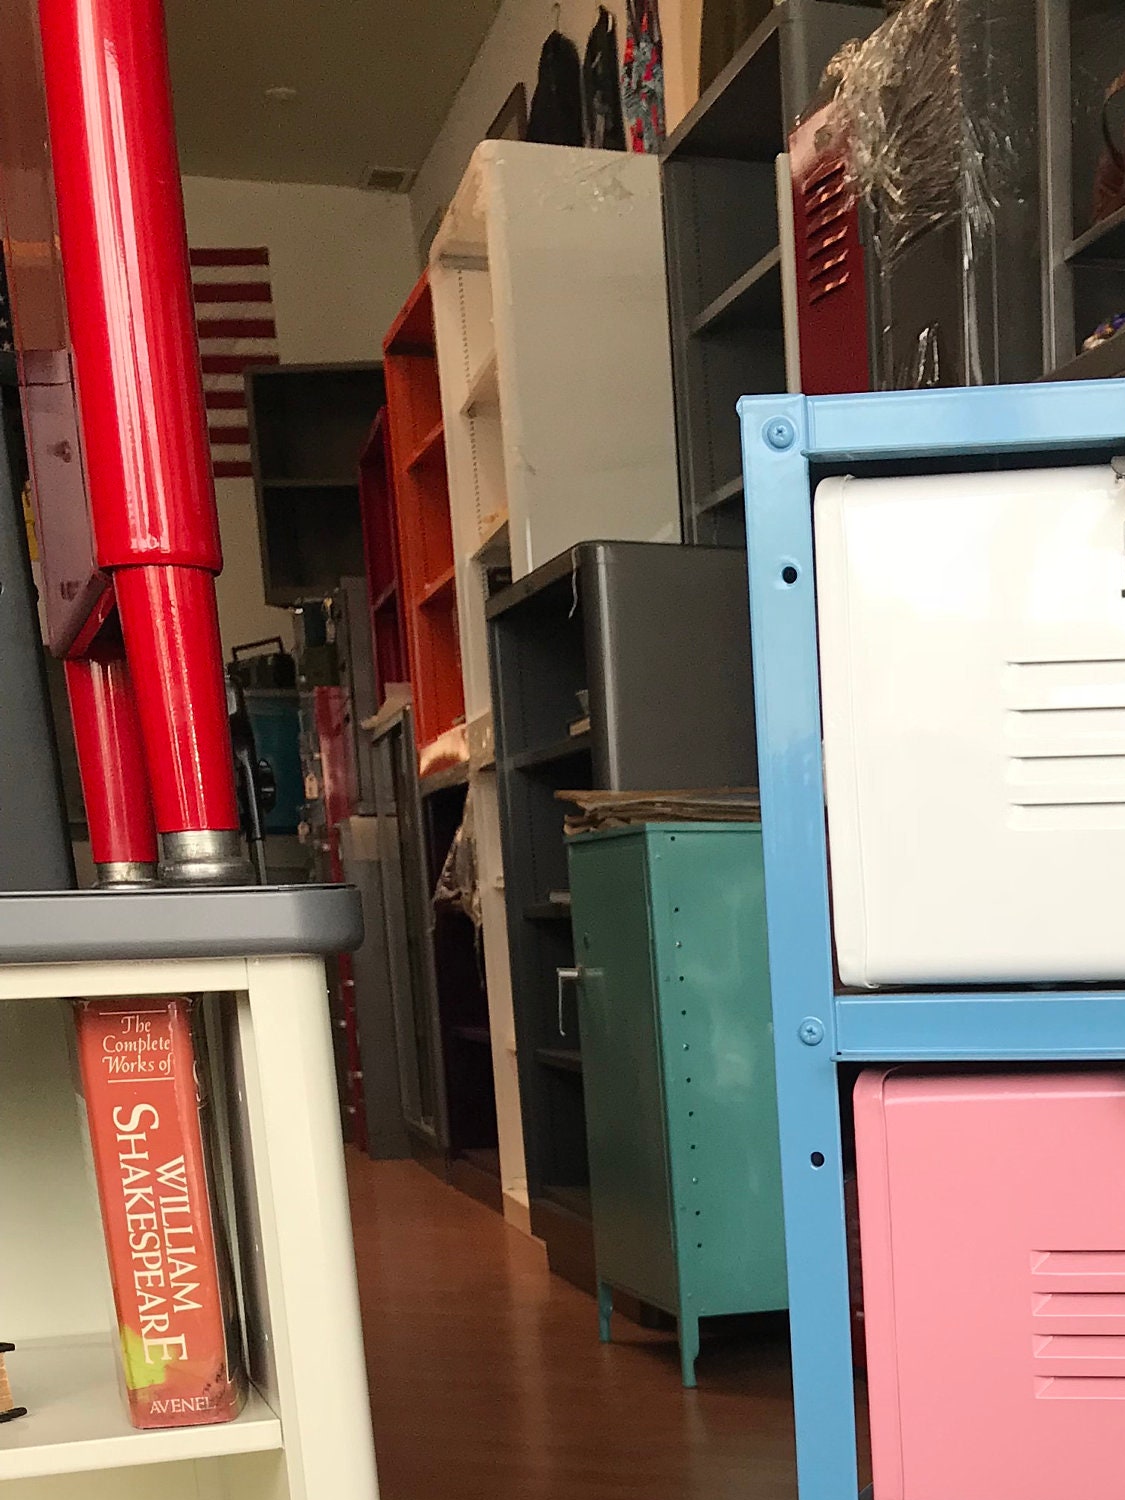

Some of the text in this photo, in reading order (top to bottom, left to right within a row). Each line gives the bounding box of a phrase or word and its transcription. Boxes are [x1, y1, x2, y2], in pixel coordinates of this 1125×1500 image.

[120, 1014, 152, 1035] The
[102, 1033, 171, 1055] Complete
[101, 1051, 174, 1076] Works of
[112, 1103, 188, 1365] SHAKESPEARE
[154, 1154, 203, 1314] WILLIAM
[149, 1396, 217, 1416] AVENEL
